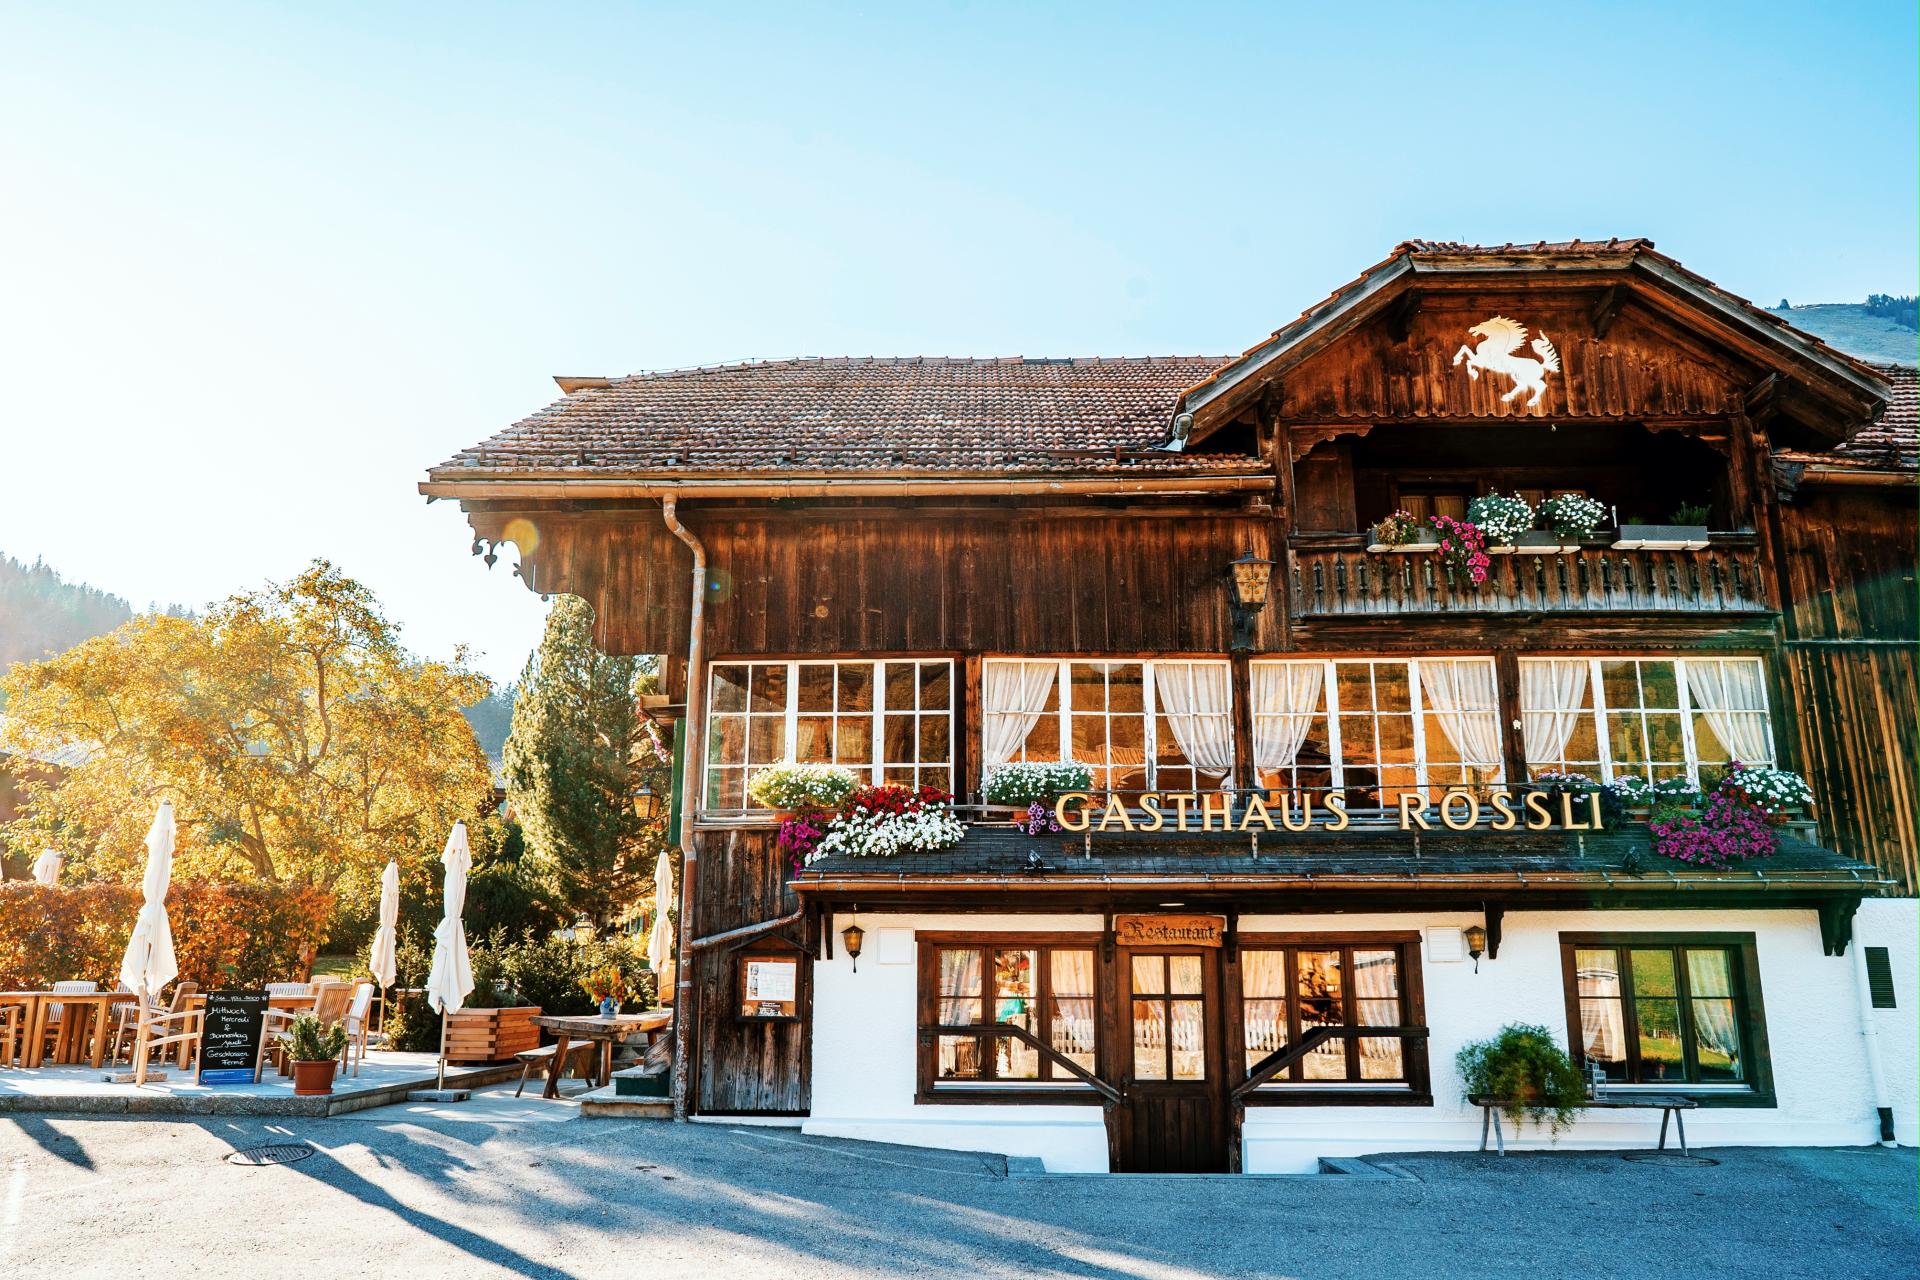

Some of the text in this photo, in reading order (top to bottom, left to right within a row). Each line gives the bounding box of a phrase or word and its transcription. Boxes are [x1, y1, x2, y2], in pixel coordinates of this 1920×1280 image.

[1055, 792, 1350, 832] GASTHAUS
[1123, 920, 1216, 941] Restaurant
[211, 1006, 247, 1014] Mittwoch
[224, 1023, 231, 1031] &
